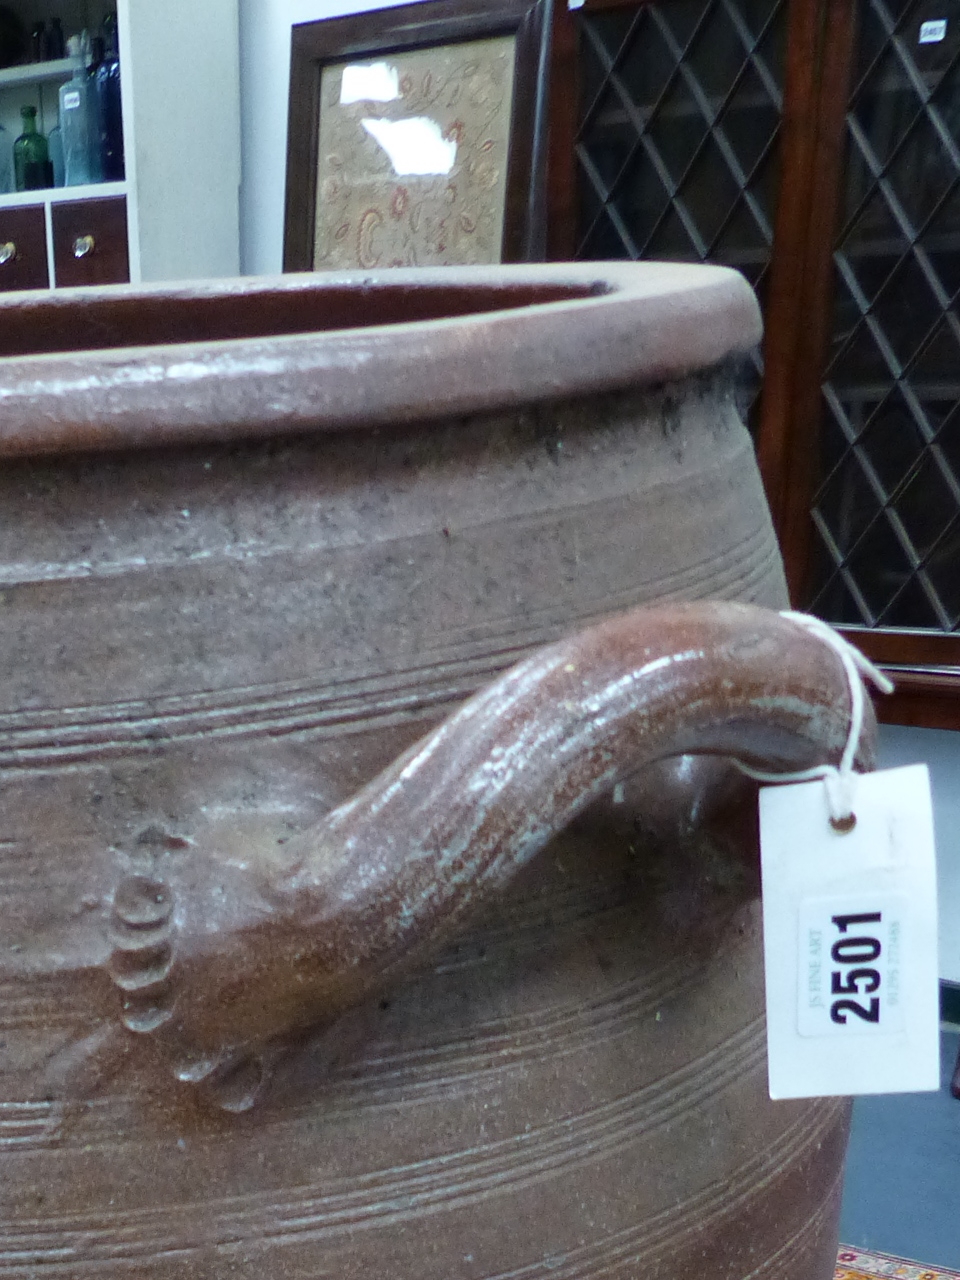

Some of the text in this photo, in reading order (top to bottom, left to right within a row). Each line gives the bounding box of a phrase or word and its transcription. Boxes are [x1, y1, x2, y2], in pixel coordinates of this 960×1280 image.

[809, 929, 821, 956] ART
[809, 961, 821, 992] FINE
[830, 912, 881, 1025] 2501
